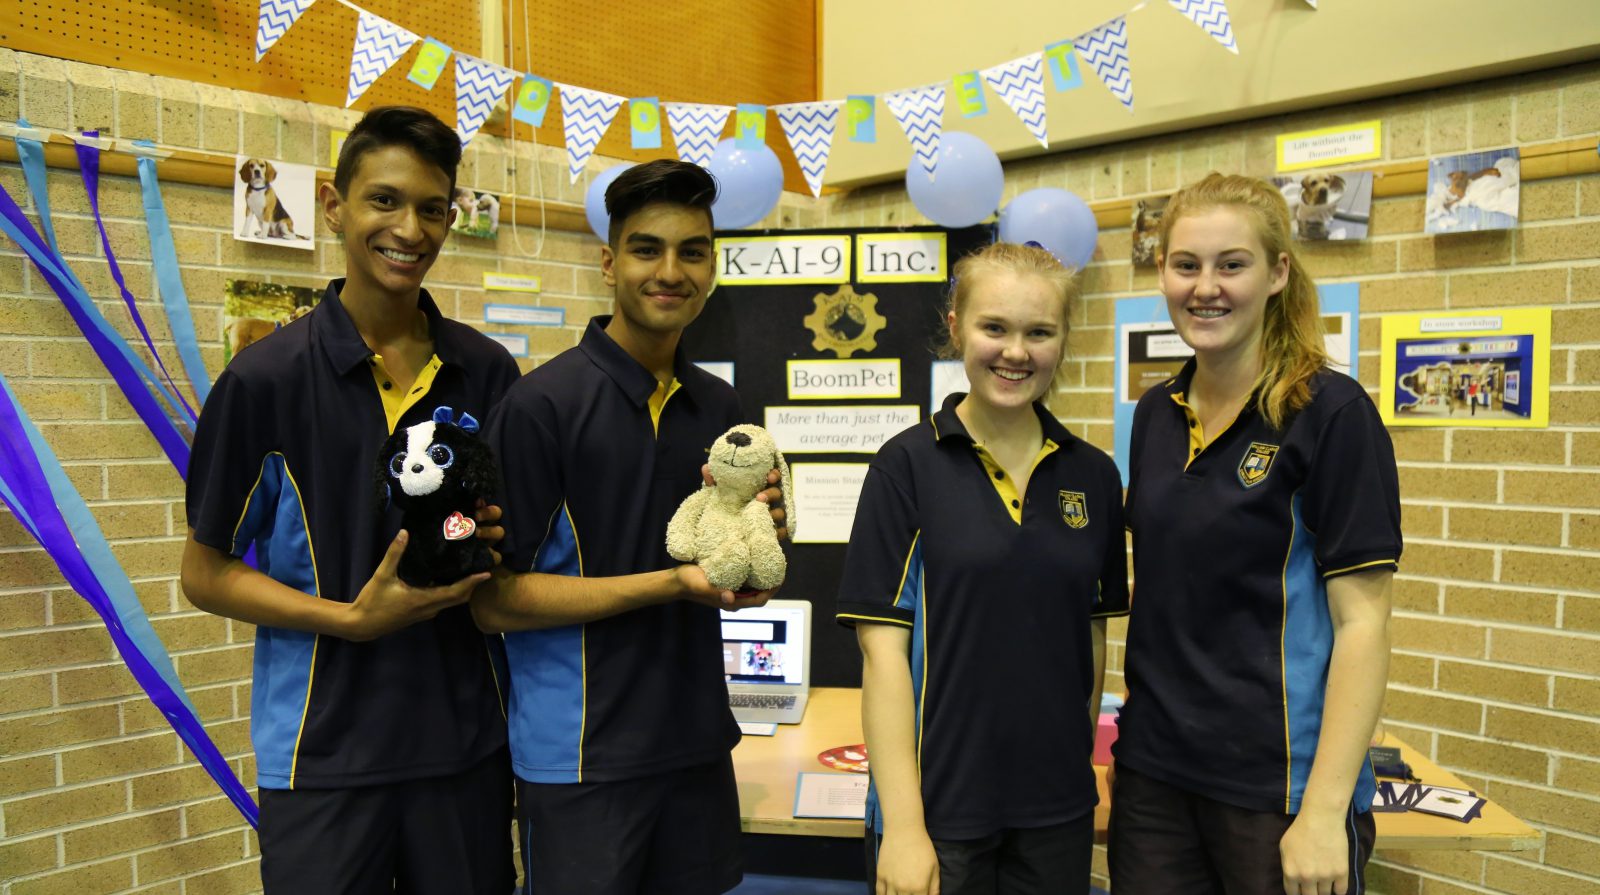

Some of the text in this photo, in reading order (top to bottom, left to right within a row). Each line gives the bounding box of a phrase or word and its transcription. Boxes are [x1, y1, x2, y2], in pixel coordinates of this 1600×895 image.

[411, 42, 1074, 139] B O O M P E T
[1294, 133, 1363, 151] Life without the
[723, 244, 936, 275] K-AI-9 Inc.
[1457, 319, 1499, 329] workshop
[793, 368, 896, 388] BoomPet
[776, 411, 909, 427] More than just the
[799, 432, 885, 447] average pet
[805, 476, 840, 485] Mission
